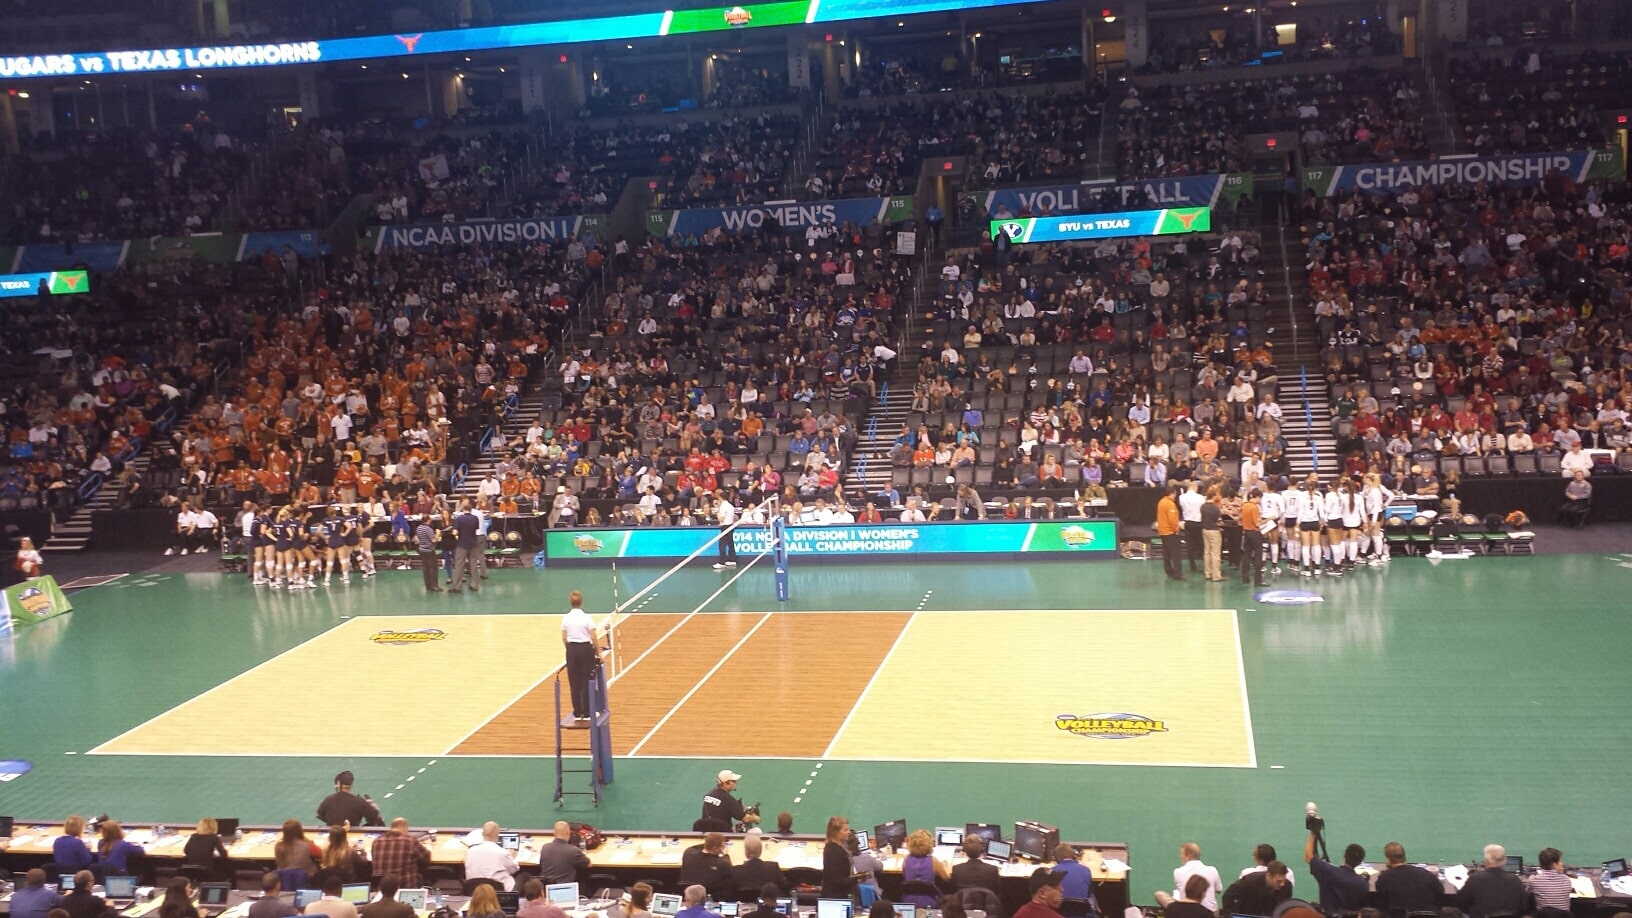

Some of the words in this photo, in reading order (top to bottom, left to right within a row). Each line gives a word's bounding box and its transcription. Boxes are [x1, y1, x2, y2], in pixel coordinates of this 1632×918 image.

[79, 56, 104, 73] vs
[106, 49, 182, 71] TEXAS
[185, 41, 322, 69] LONGHORNS
[1597, 153, 1613, 162] 117
[1308, 171, 1323, 180] 117
[1355, 156, 1571, 190] CHAMPIONSHIP
[1227, 176, 1243, 185] 116
[891, 199, 905, 208] 115
[585, 218, 598, 226] 114
[650, 215, 663, 223] 115
[721, 204, 836, 230] WOMEN'S
[1058, 222, 1081, 233] BYU
[1082, 222, 1094, 231] vs
[1095, 219, 1130, 230] TEXAS
[391, 226, 456, 247] NCAA
[458, 221, 552, 244] DIVISION
[561, 220, 568, 239] I
[732, 531, 753, 542] 014
[756, 531, 791, 542] NCA
[793, 530, 849, 541] DIVISION
[858, 529, 919, 539] WOMEN'S
[733, 541, 814, 552] VOLLEBALL
[815, 540, 914, 551] CHAMPIONSHIP
[1055, 718, 1165, 731] VOLLEYBALL
